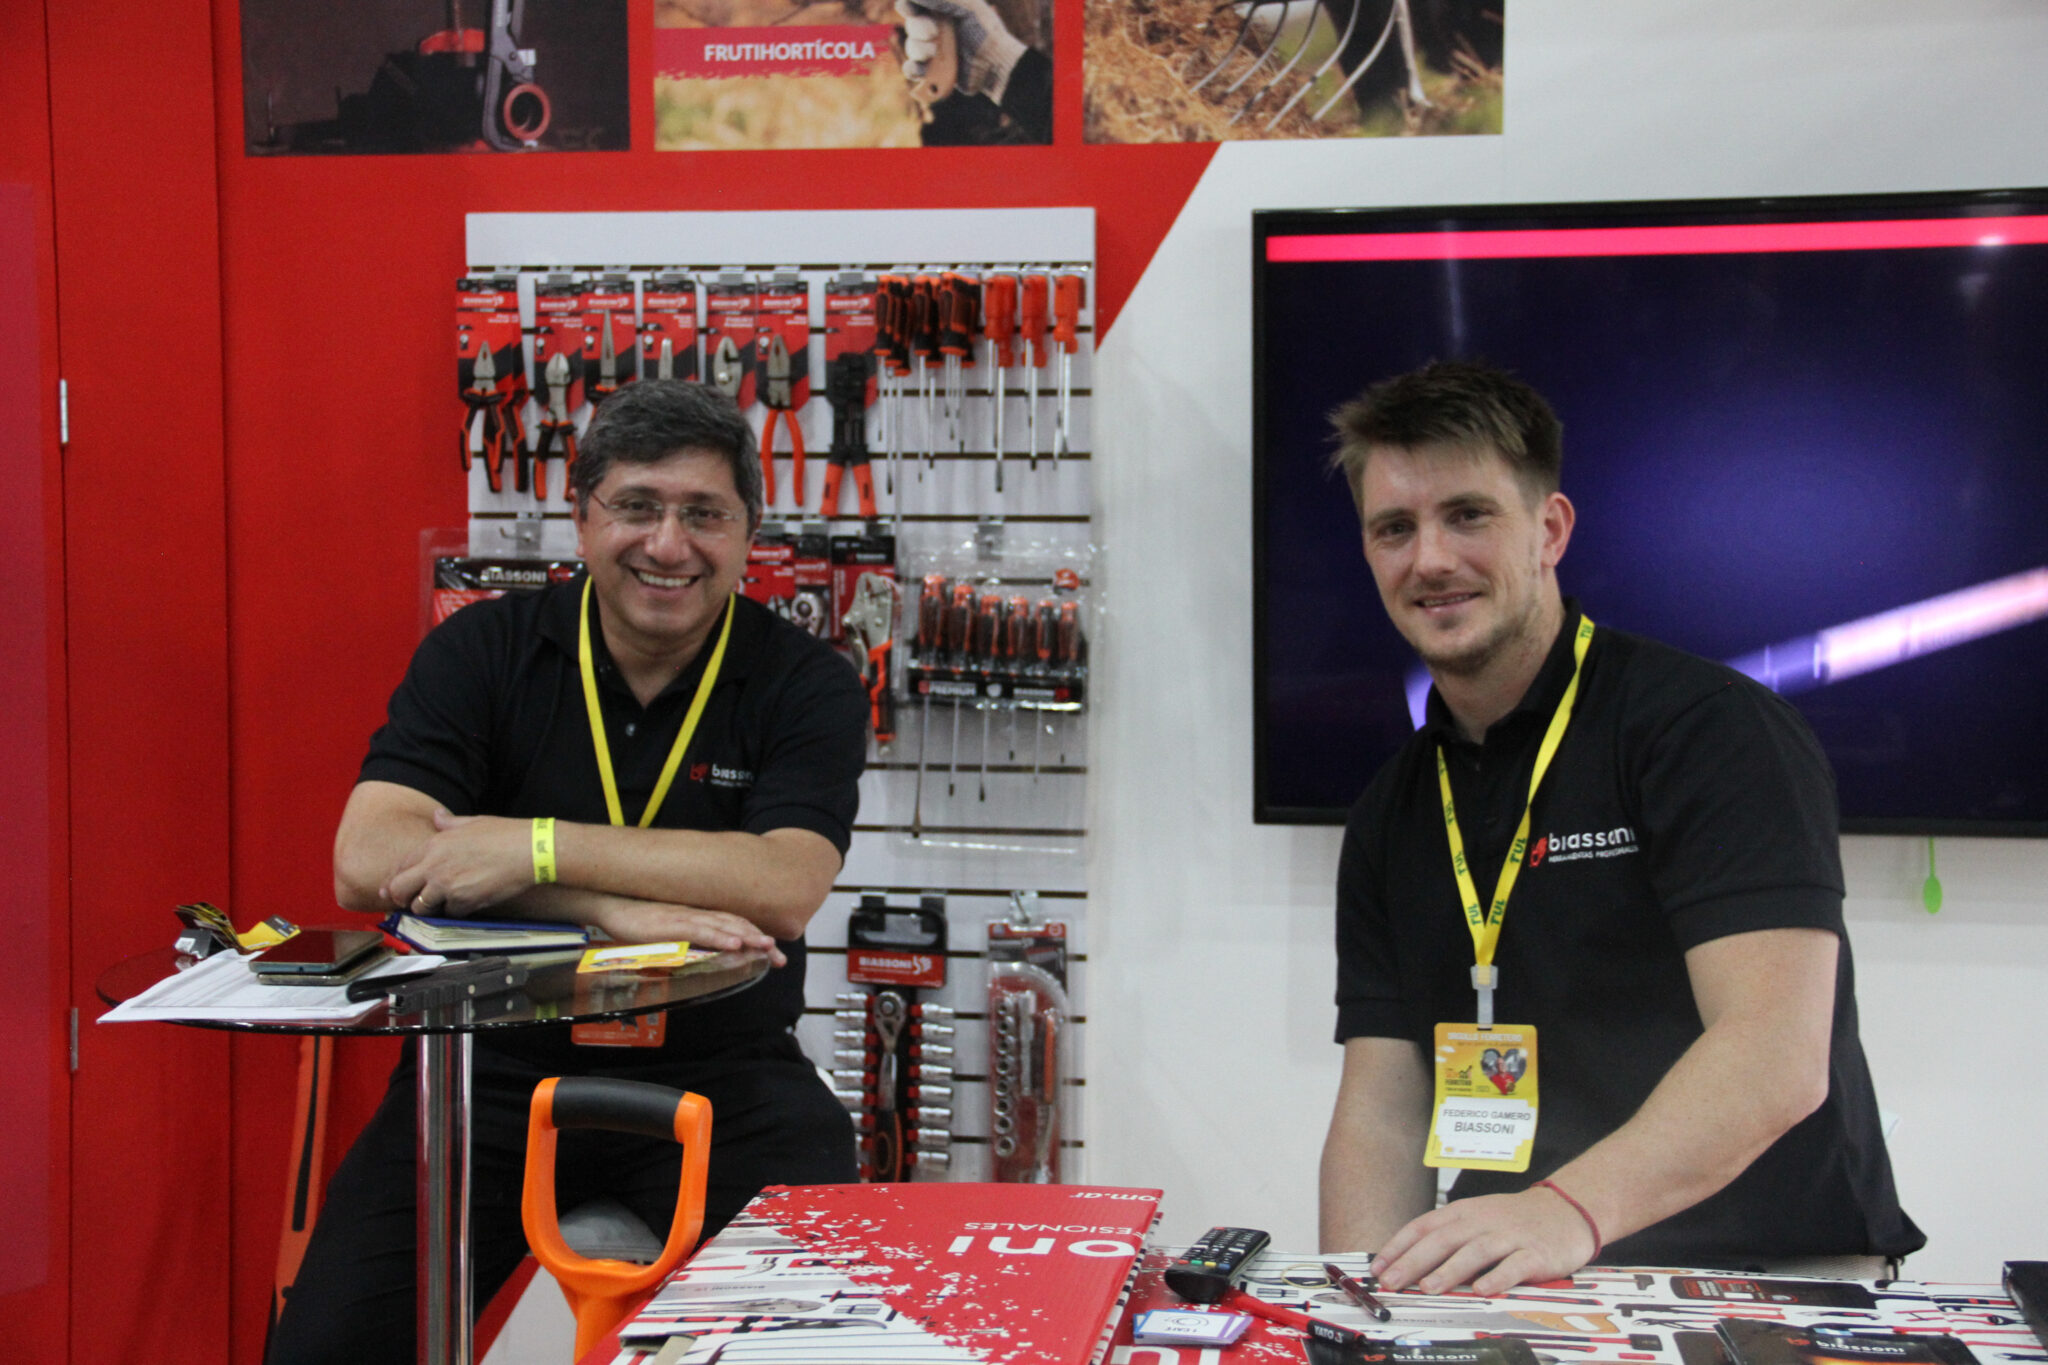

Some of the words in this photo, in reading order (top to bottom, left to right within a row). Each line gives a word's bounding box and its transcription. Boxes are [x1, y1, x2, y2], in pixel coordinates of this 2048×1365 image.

[704, 40, 875, 61] FRUTIHORTÍCOLA
[1509, 838, 1528, 864] TUL
[1453, 851, 1468, 876] TUL
[1466, 903, 1482, 926] TUL
[1490, 899, 1506, 925] TUL
[1443, 1109, 1488, 1118] FEDERICO
[1491, 1111, 1531, 1121] GAMERO
[1454, 1121, 1515, 1135] BIASSONI
[1068, 1191, 1161, 1203] om.ar
[1314, 1325, 1334, 1341] YATO
[1816, 1338, 1905, 1353] biassoni
[1393, 1353, 1477, 1361] biassoni
